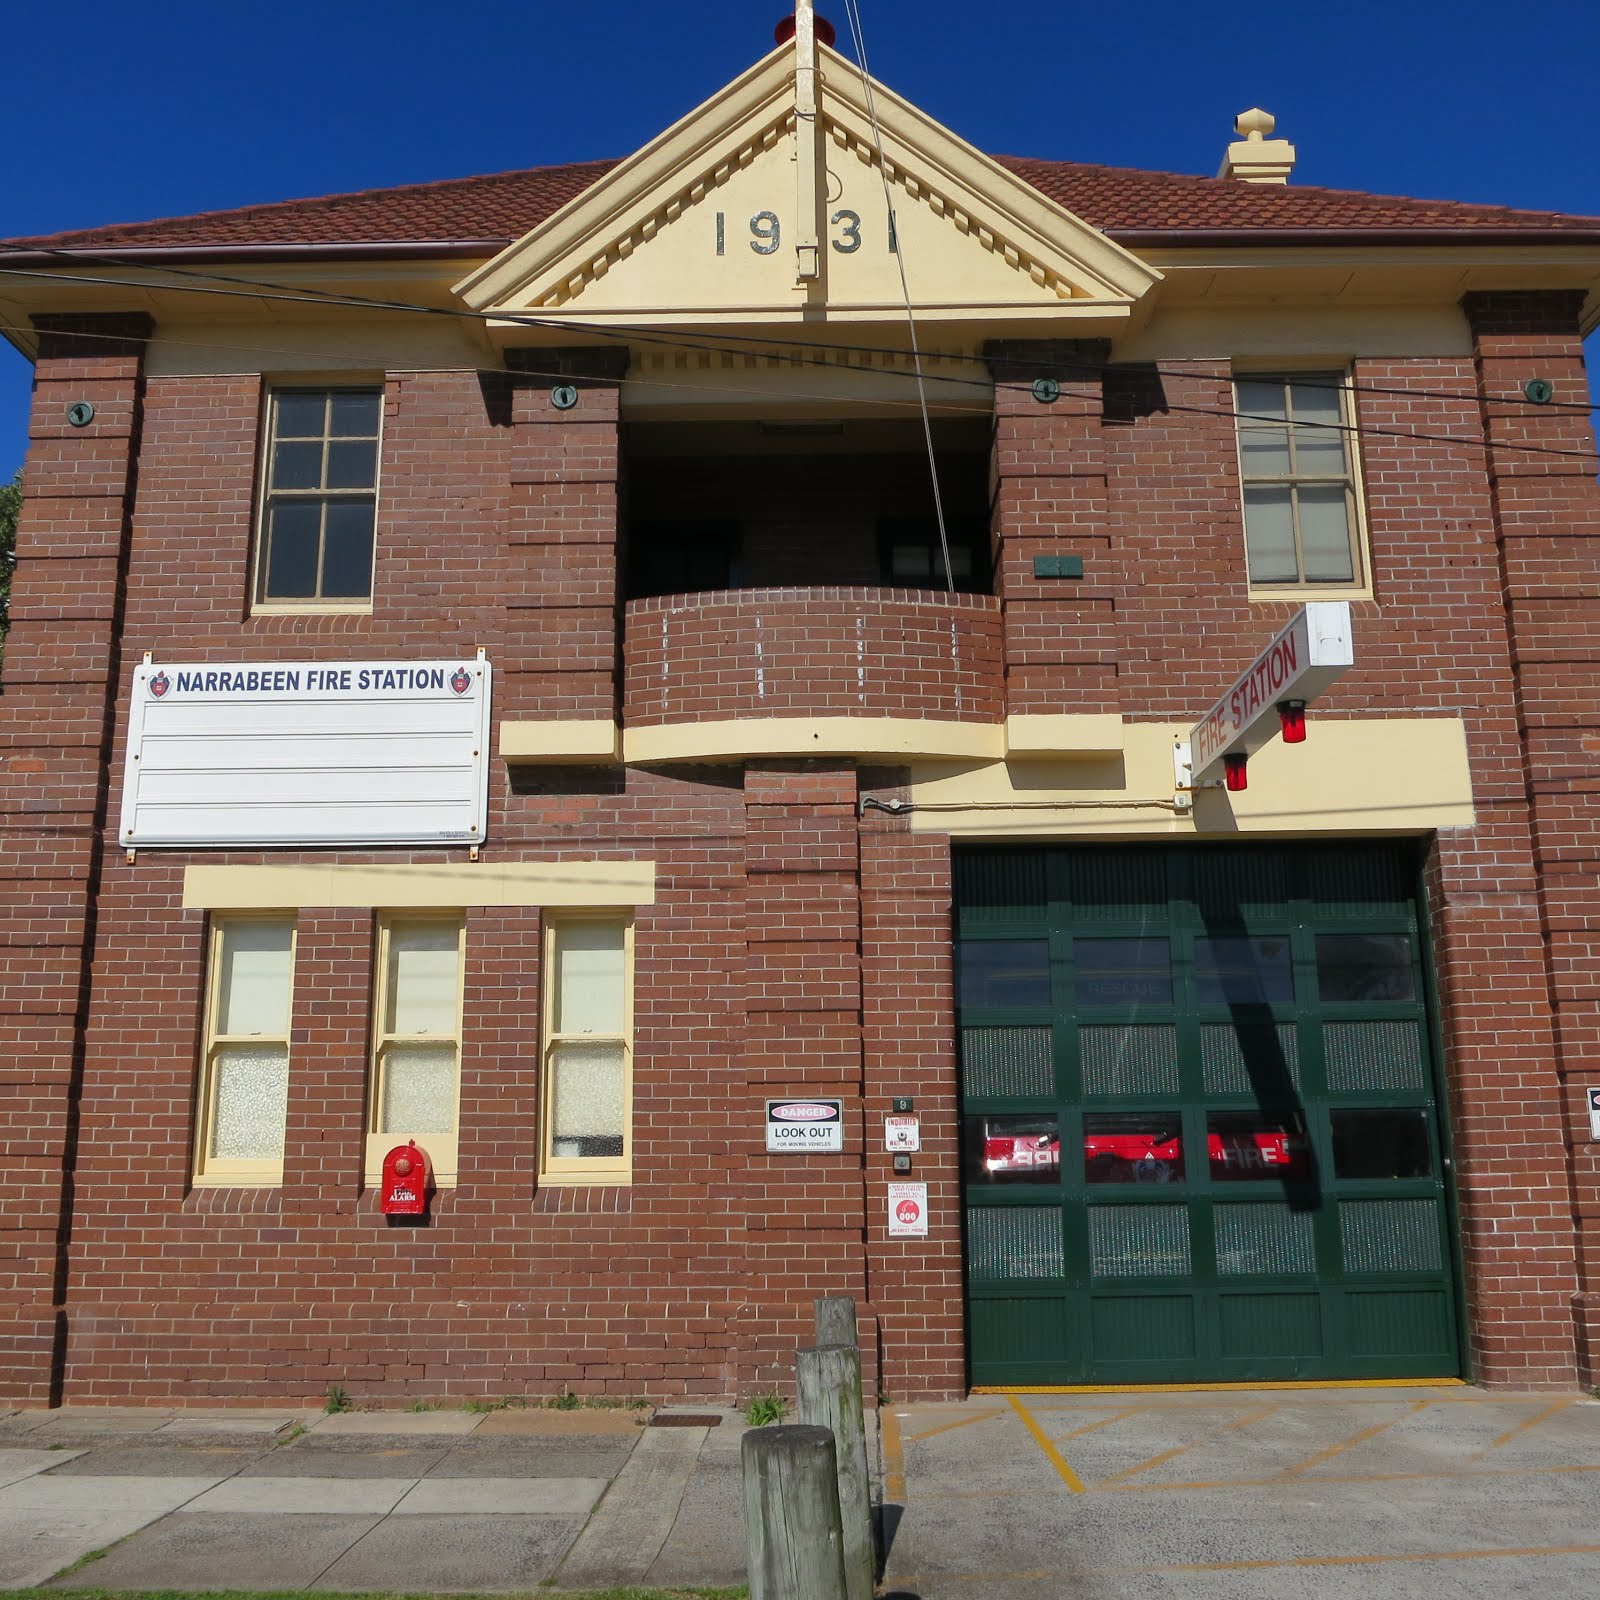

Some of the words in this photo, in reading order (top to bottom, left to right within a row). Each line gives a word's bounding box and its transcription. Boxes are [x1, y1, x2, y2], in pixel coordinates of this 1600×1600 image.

[716, 209, 897, 256] 1931
[176, 670, 300, 692] NARRABEEN
[306, 670, 352, 691] FIRE
[358, 668, 445, 690] STATION
[1198, 707, 1227, 763] FIRE
[1231, 631, 1298, 731] STATION
[780, 1108, 827, 1116] DANGER
[899, 1100, 907, 1110] 9
[775, 1127, 807, 1138] LOOK
[809, 1127, 833, 1138] OUT
[1222, 1148, 1279, 1168] FIRE
[900, 1212, 916, 1220] 000
